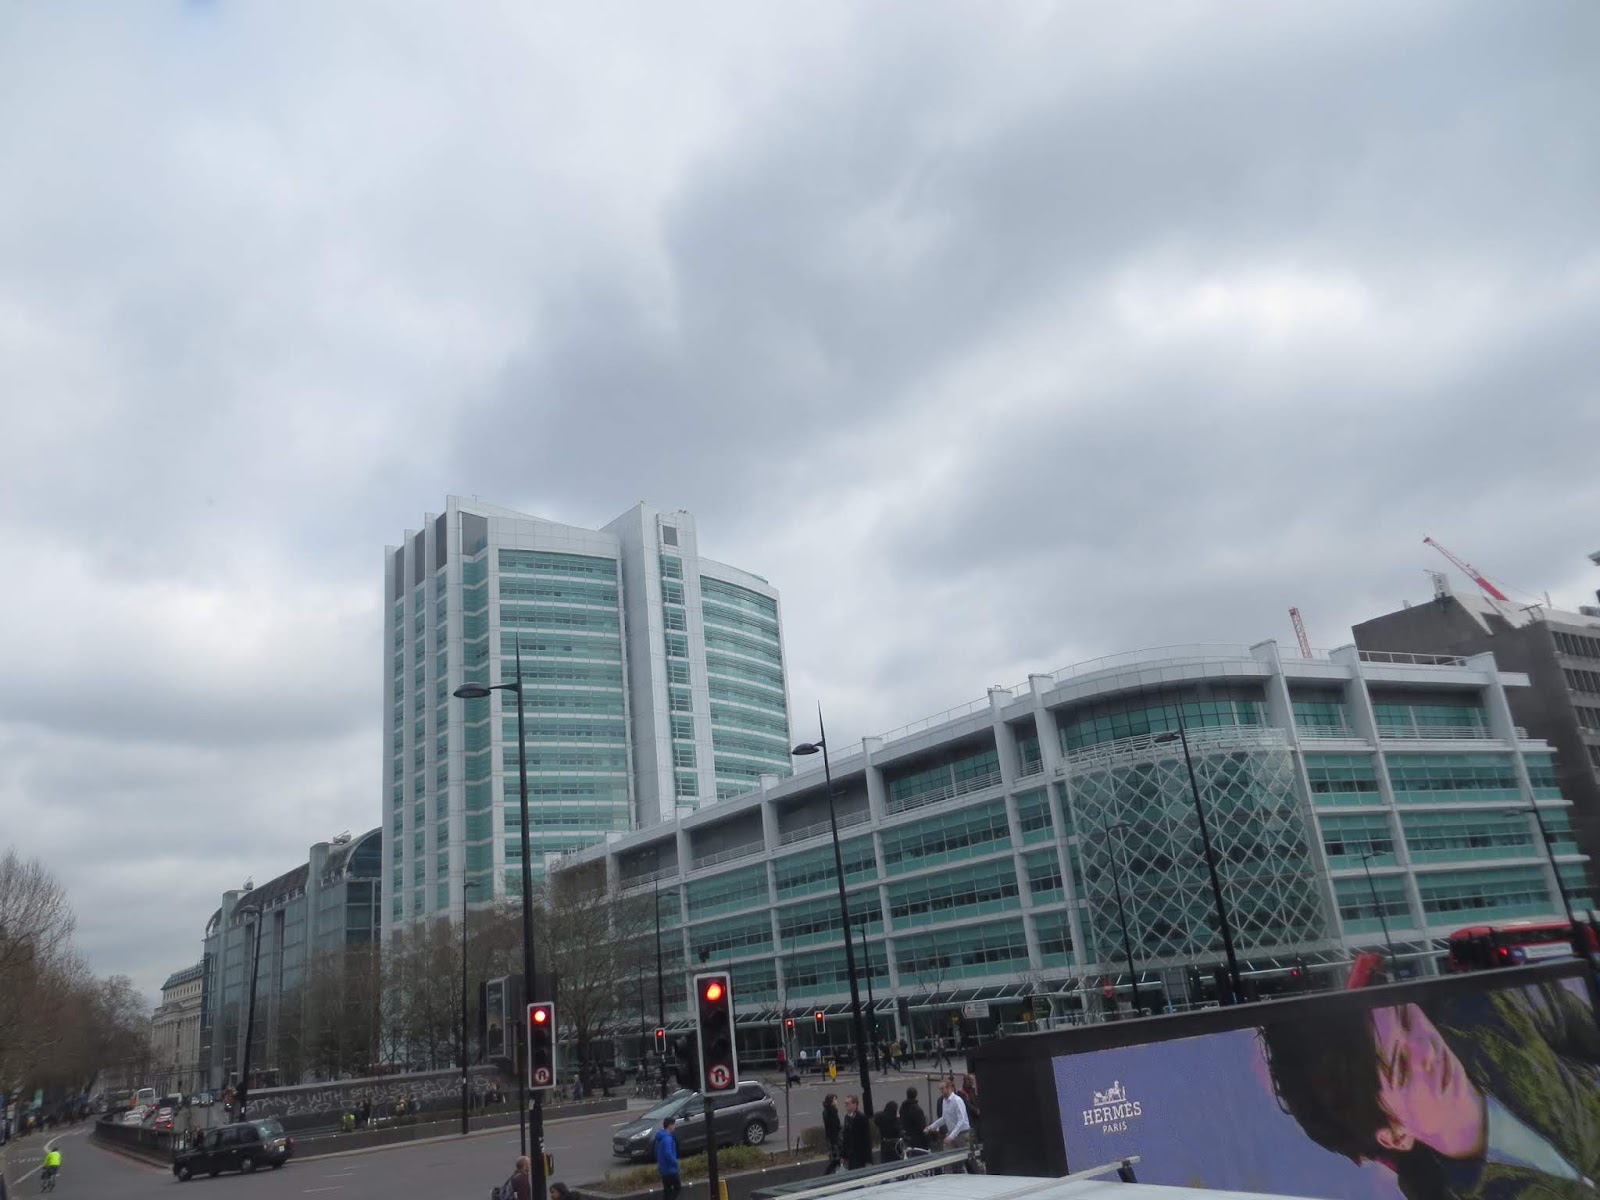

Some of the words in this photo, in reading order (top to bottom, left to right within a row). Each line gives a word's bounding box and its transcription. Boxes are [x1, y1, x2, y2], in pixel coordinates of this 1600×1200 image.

[246, 1094, 301, 1114] STAND
[307, 1089, 344, 1105] WITH
[287, 1102, 332, 1116] END
[1102, 1121, 1127, 1133] PARIS
